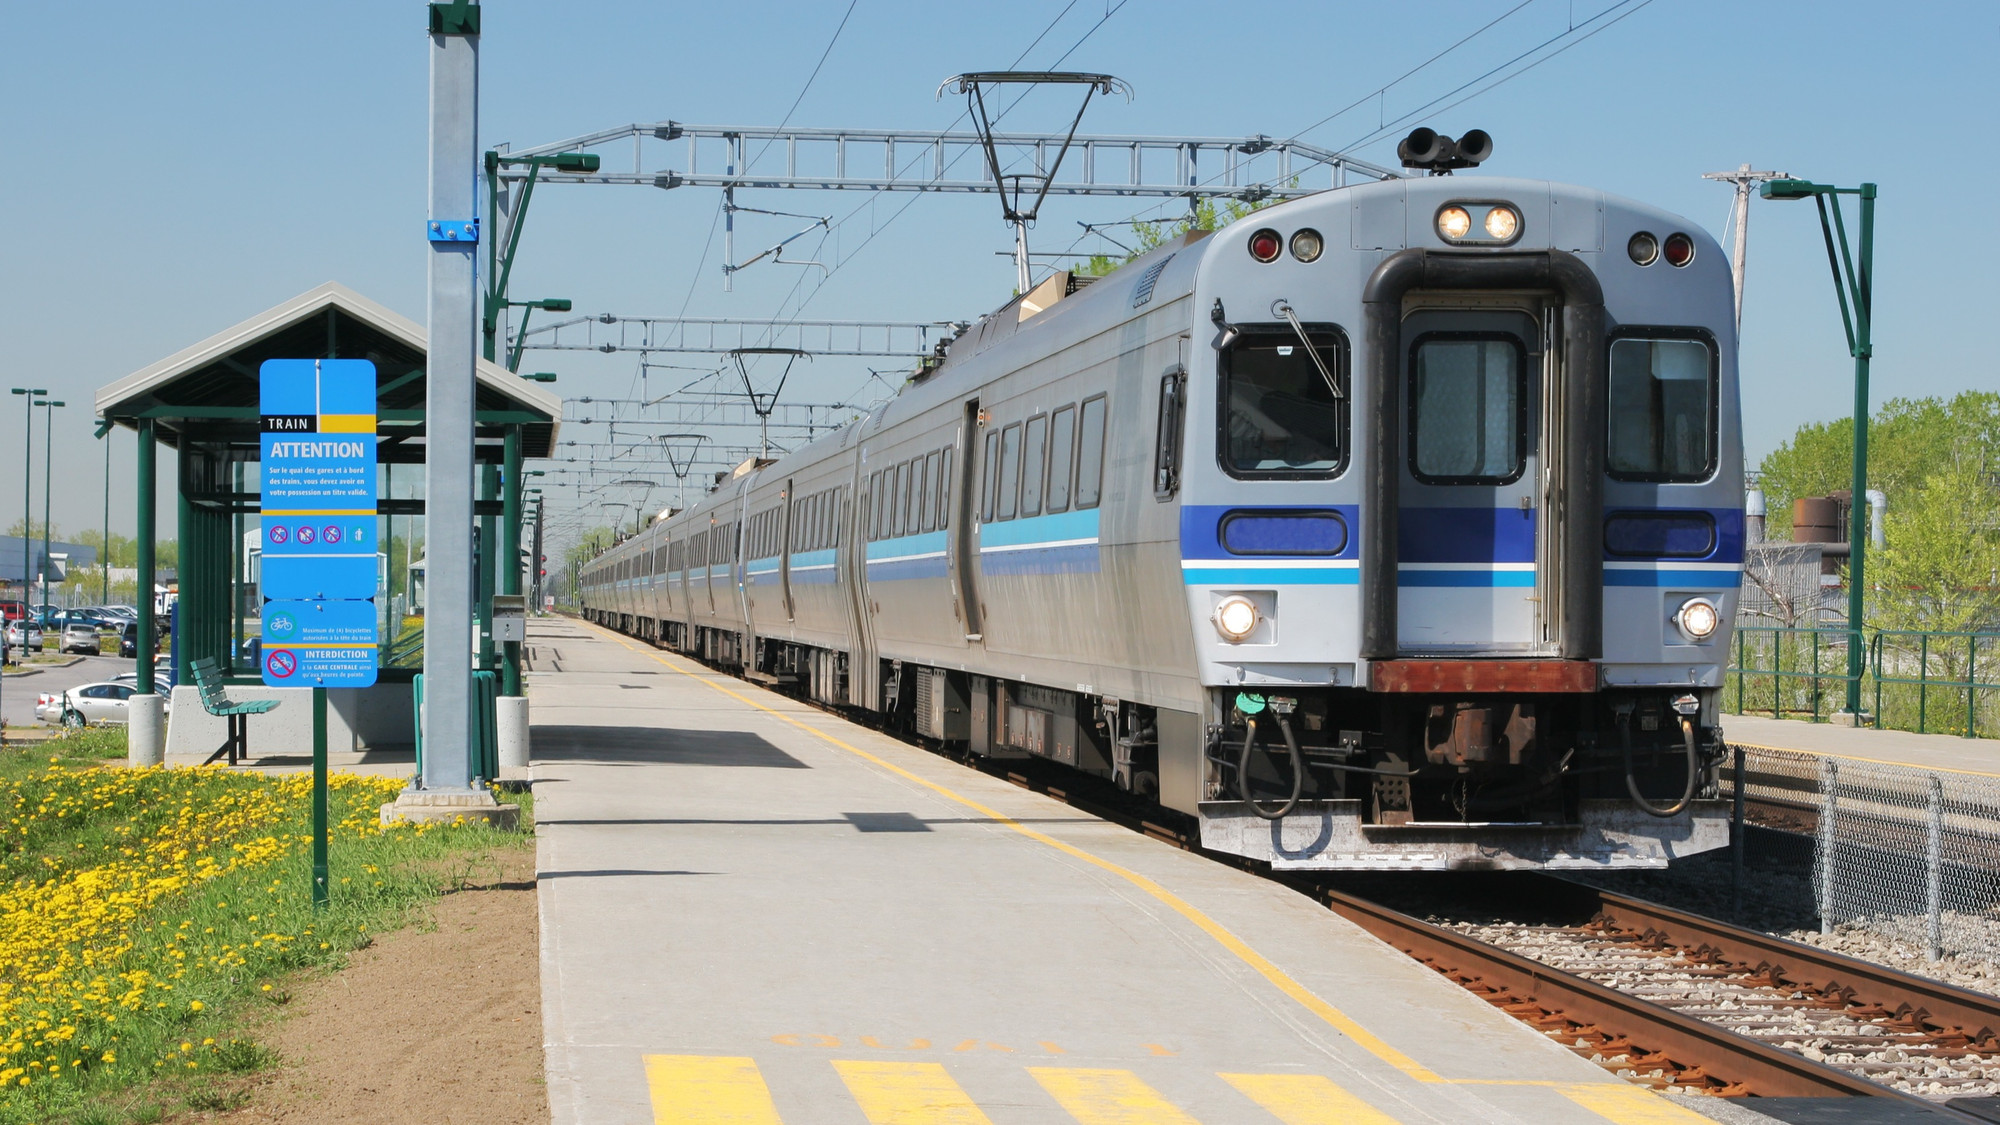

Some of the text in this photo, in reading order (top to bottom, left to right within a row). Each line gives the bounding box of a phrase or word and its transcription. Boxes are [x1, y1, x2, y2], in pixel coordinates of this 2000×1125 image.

[268, 418, 308, 430] TRAIN
[270, 442, 364, 458] ATTENTION
[289, 467, 303, 475] quai
[287, 489, 321, 497] possession
[305, 650, 368, 659] INTERDICTION
